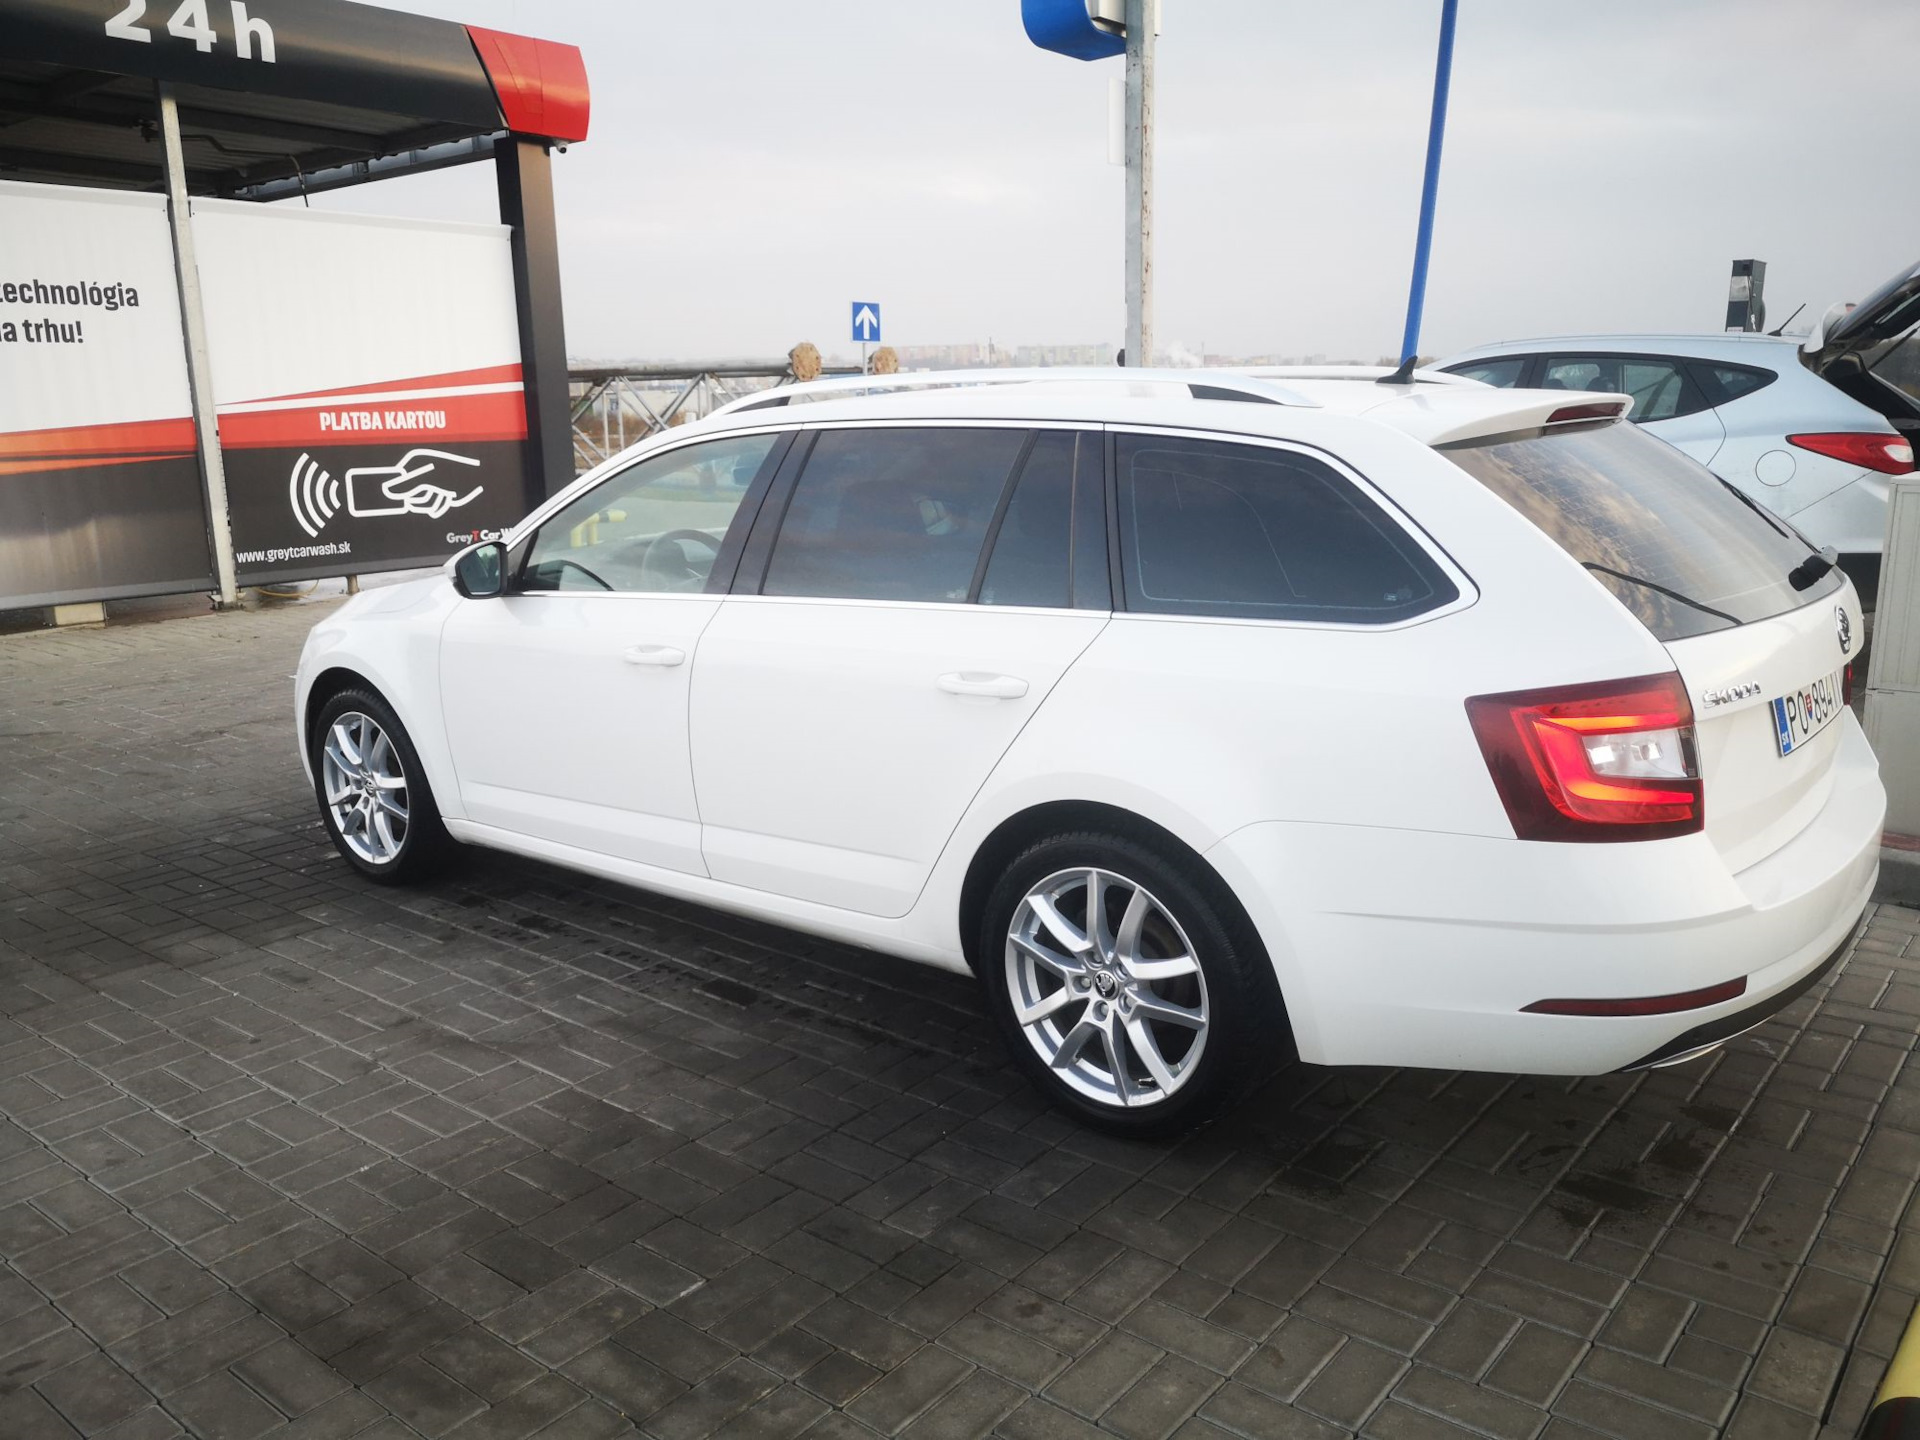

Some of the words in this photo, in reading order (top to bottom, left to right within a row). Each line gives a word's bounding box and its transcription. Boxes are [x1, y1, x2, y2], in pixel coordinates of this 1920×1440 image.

[22, 318, 84, 343] trhu!
[319, 411, 383, 431] PLATBA
[384, 410, 446, 430] KARTOU
[236, 541, 351, 563] www.greytcarwash.sk
